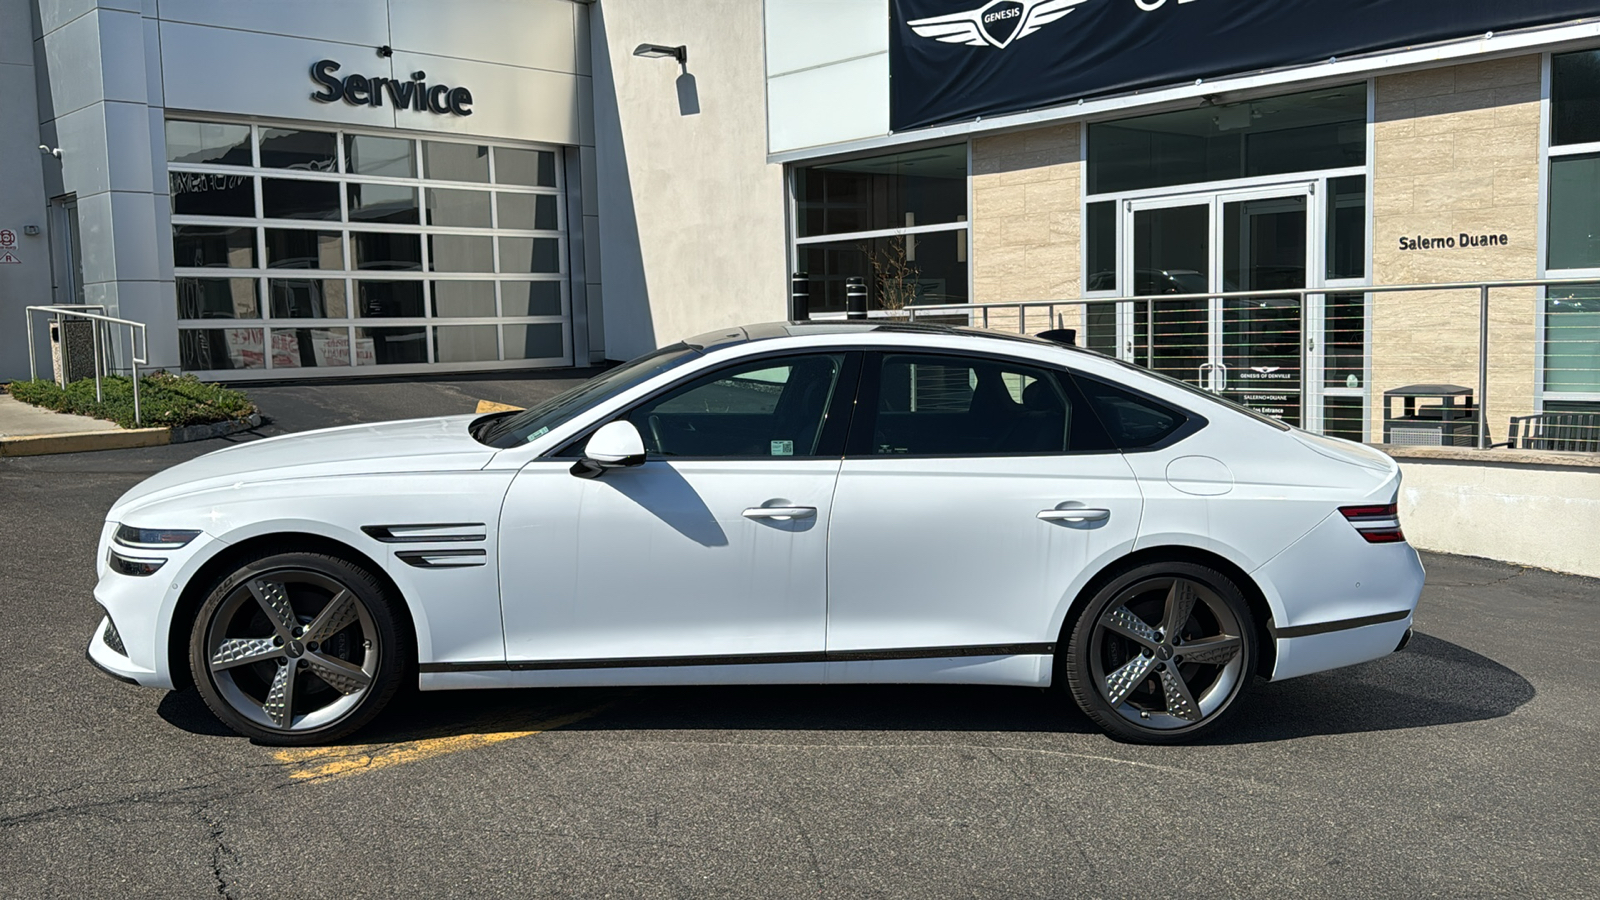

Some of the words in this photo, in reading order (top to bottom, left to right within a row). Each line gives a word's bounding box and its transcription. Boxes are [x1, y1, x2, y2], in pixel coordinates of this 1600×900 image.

[984, 7, 1020, 23] GENESIS
[310, 59, 474, 117] Service
[1398, 235, 1456, 250] Salerno
[1459, 233, 1508, 248] Duane
